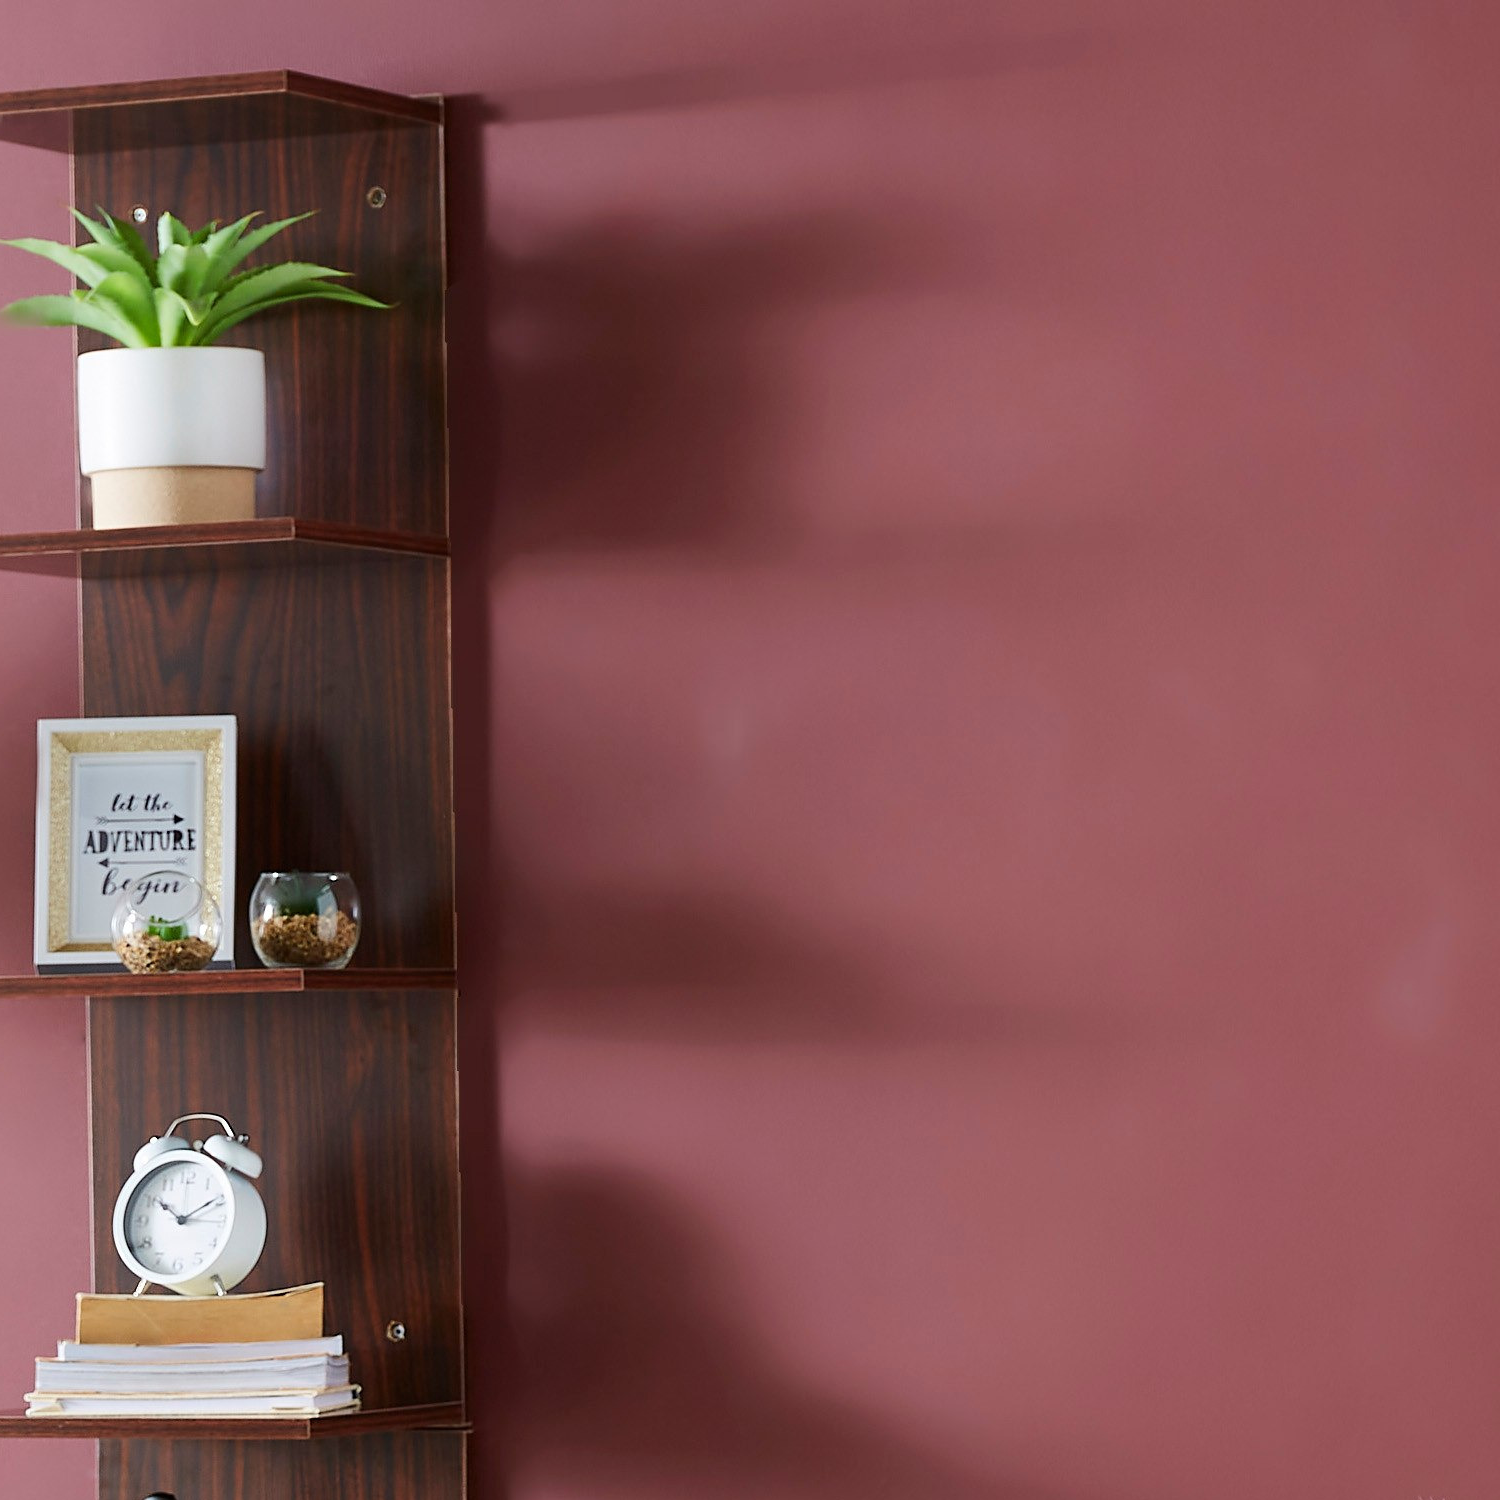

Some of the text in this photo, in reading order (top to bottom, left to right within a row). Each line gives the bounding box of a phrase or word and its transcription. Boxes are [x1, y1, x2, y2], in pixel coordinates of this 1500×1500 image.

[111, 793, 173, 812] let the
[83, 828, 197, 854] ADVENTURE
[102, 867, 186, 905] begin
[162, 1177, 174, 1191] 11
[180, 1169, 196, 1185] 12
[172, 1257, 184, 1271] 6
